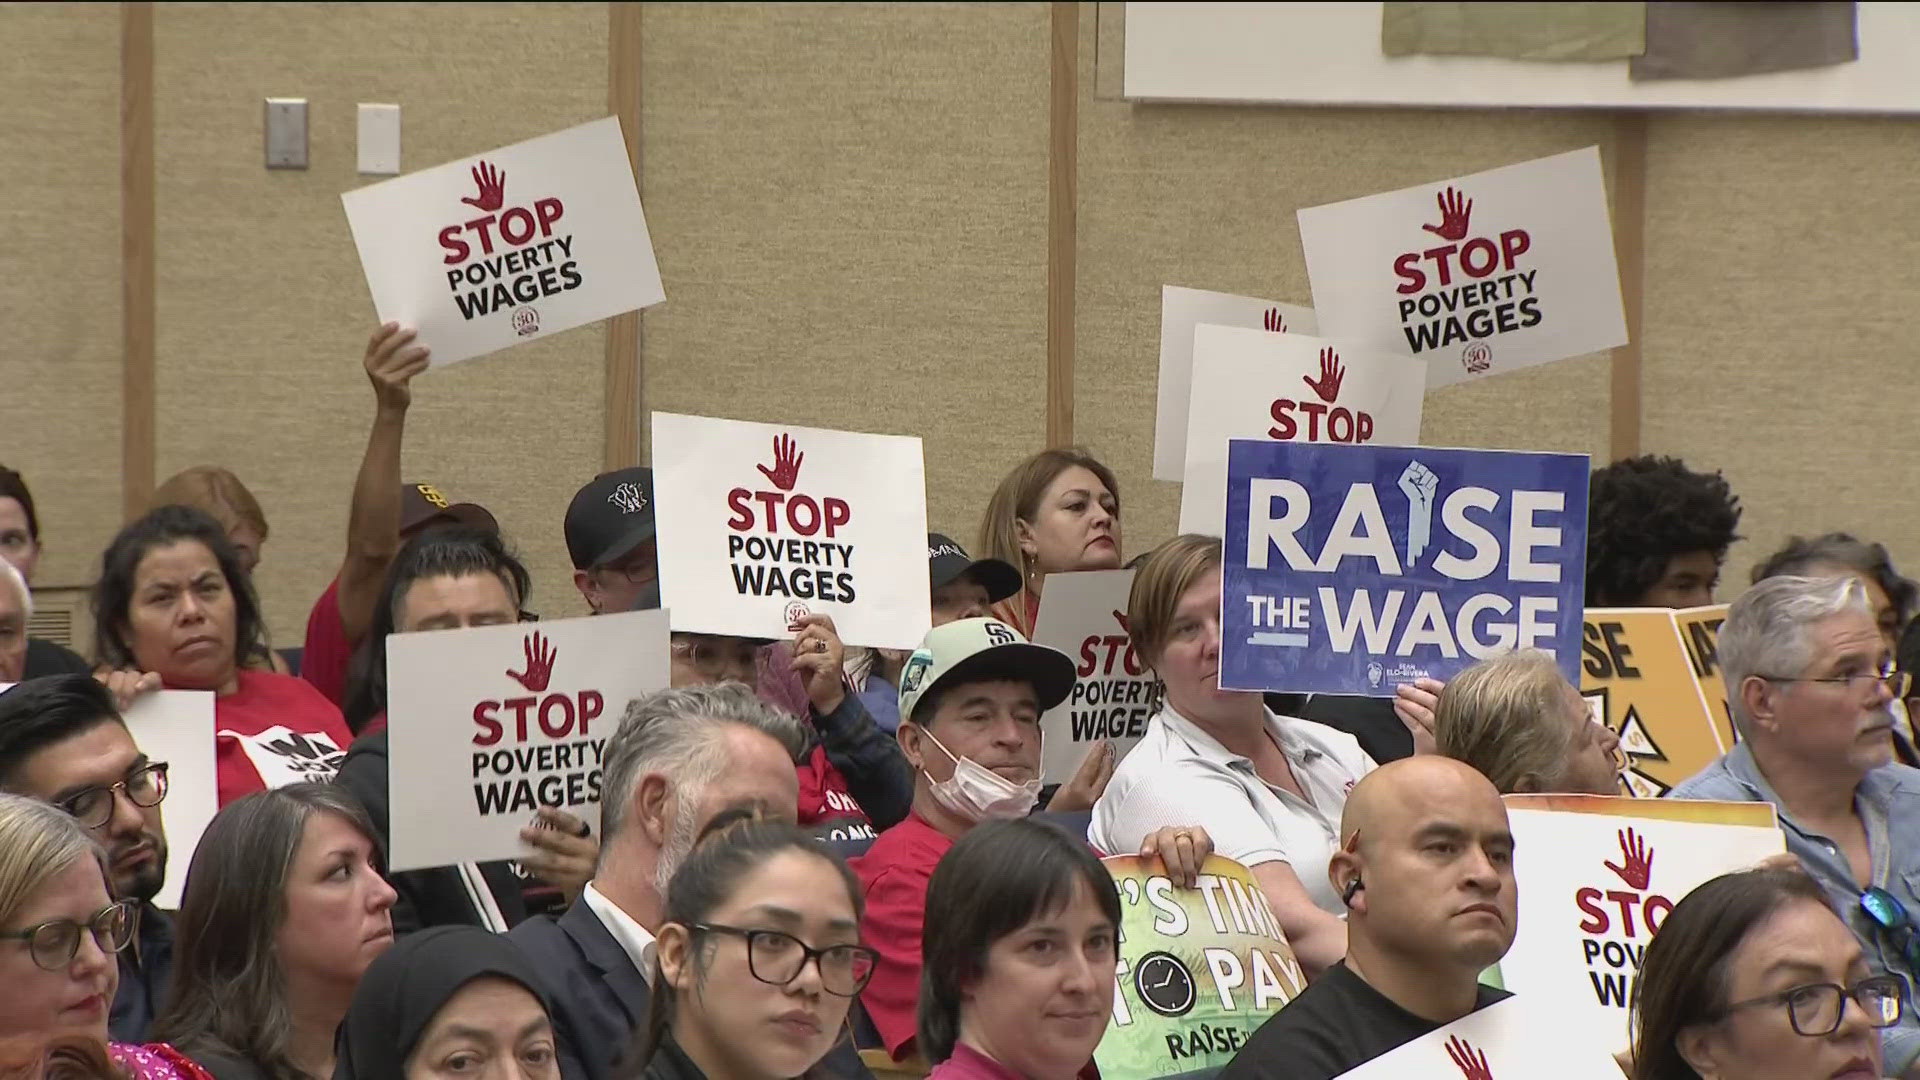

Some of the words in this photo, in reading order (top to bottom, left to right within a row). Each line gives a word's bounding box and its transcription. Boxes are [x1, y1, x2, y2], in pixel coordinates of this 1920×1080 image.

[438, 197, 564, 264] STOP
[447, 235, 573, 291] POVERTY
[1393, 229, 1530, 294] STOP
[454, 261, 582, 321] WAGES
[1398, 269, 1537, 322] POVERTY
[1403, 297, 1542, 354] WAGES
[1268, 399, 1374, 444] STOP
[727, 488, 851, 538] STOP
[728, 535, 854, 568] POVERTY
[731, 563, 856, 604] WAGES
[1246, 595, 1310, 629] THE
[1317, 586, 1559, 661] WAGE
[1077, 635, 1143, 678] STO
[472, 690, 604, 747] STOP
[1071, 680, 1154, 706] POVERT
[1070, 707, 1156, 742] WAGE
[472, 738, 605, 779] POVERTY
[473, 769, 603, 816] WAGES
[1194, 873, 1289, 947] TIM
[1575, 887, 1676, 938] STO
